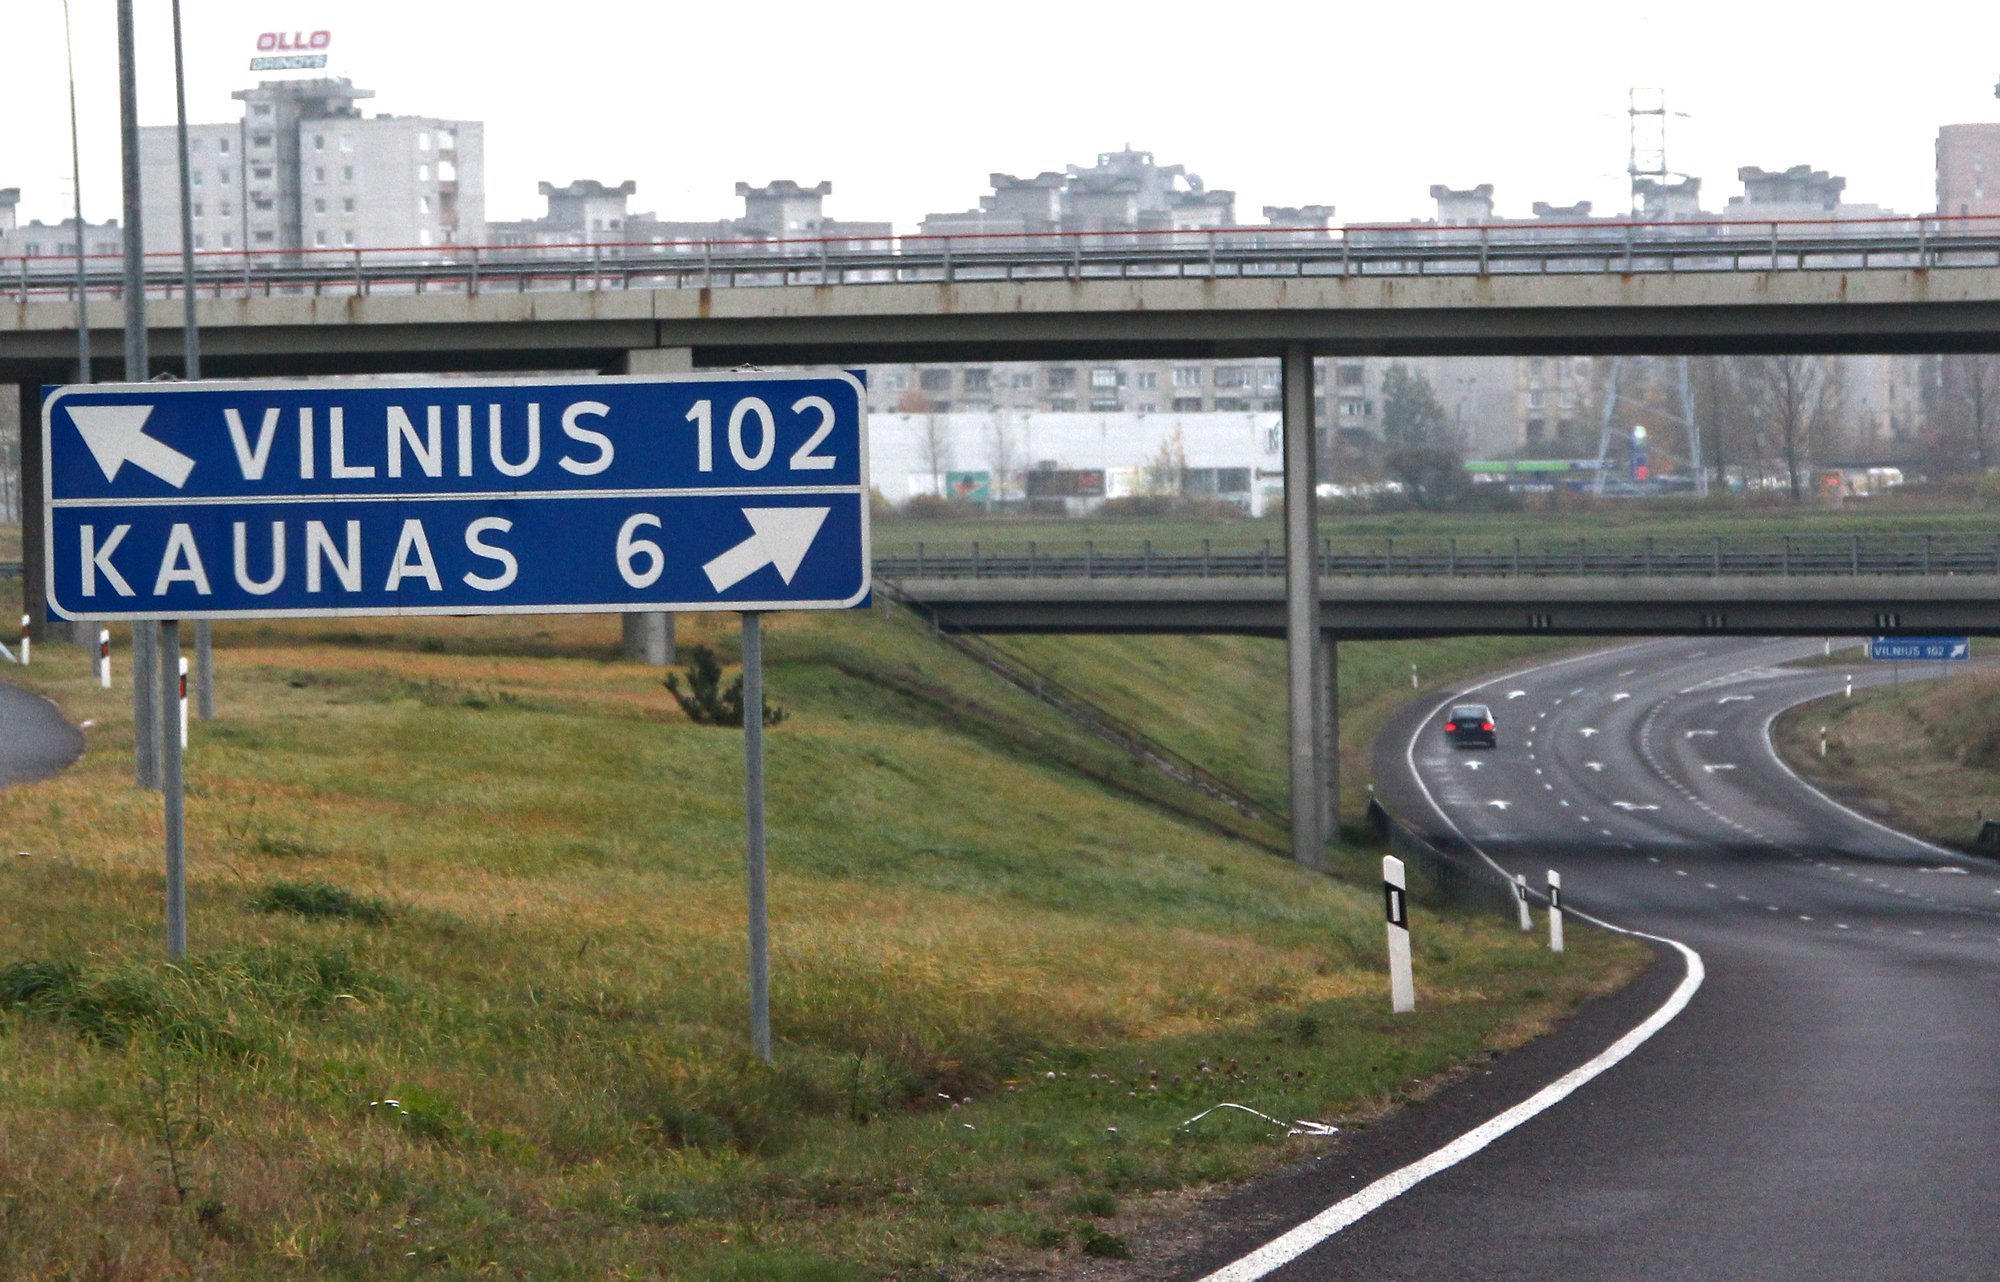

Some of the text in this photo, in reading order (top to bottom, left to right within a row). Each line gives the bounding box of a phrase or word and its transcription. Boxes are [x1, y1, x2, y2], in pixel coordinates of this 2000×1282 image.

[256, 30, 331, 50] OLLO
[225, 396, 836, 479] VILNIUS 102
[81, 513, 664, 596] KAUNAS 6
[1875, 646, 1944, 656] VILNIUS 102
